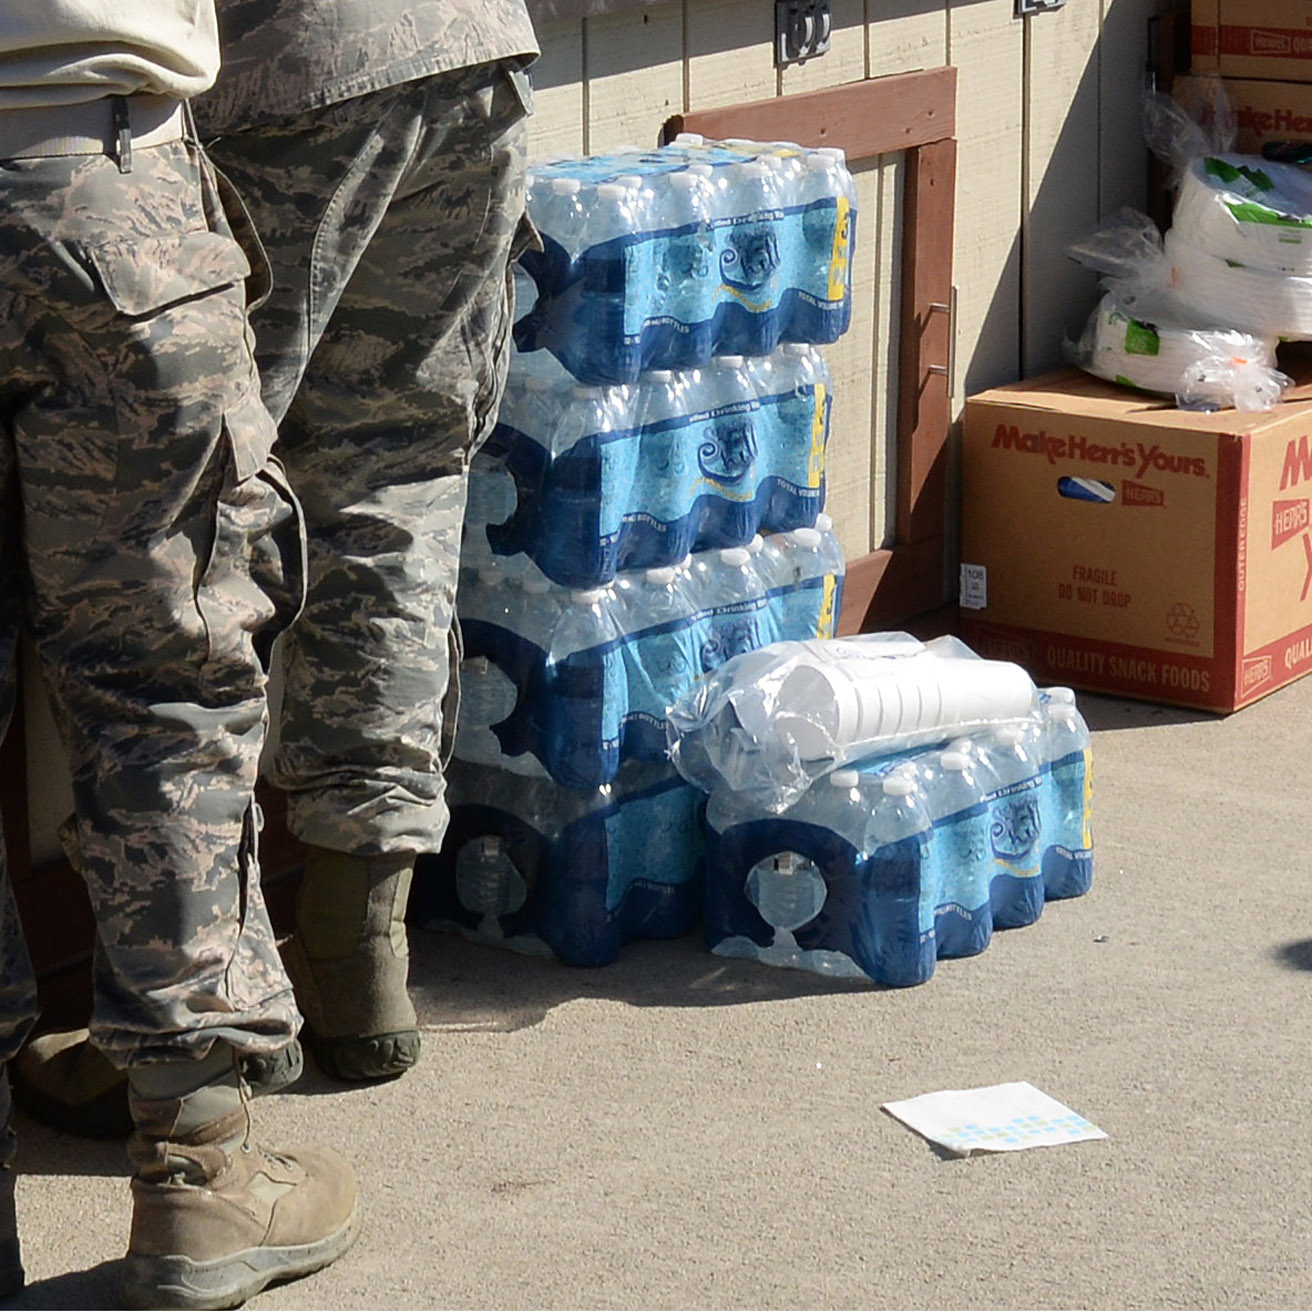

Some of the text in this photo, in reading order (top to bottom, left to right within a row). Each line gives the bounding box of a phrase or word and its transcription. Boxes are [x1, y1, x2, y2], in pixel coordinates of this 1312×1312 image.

[991, 423, 1066, 466] Make
[1068, 435, 1135, 467] Herr's
[1240, 498, 1248, 538] EDGE
[1073, 565, 1118, 586] FRAGILE
[1238, 539, 1246, 592] OUTER
[1058, 584, 1132, 609] DO NOT DROP
[1047, 645, 1105, 676] QUALITY
[1109, 655, 1158, 685] SNACK
[1161, 663, 1210, 693] FOODS
